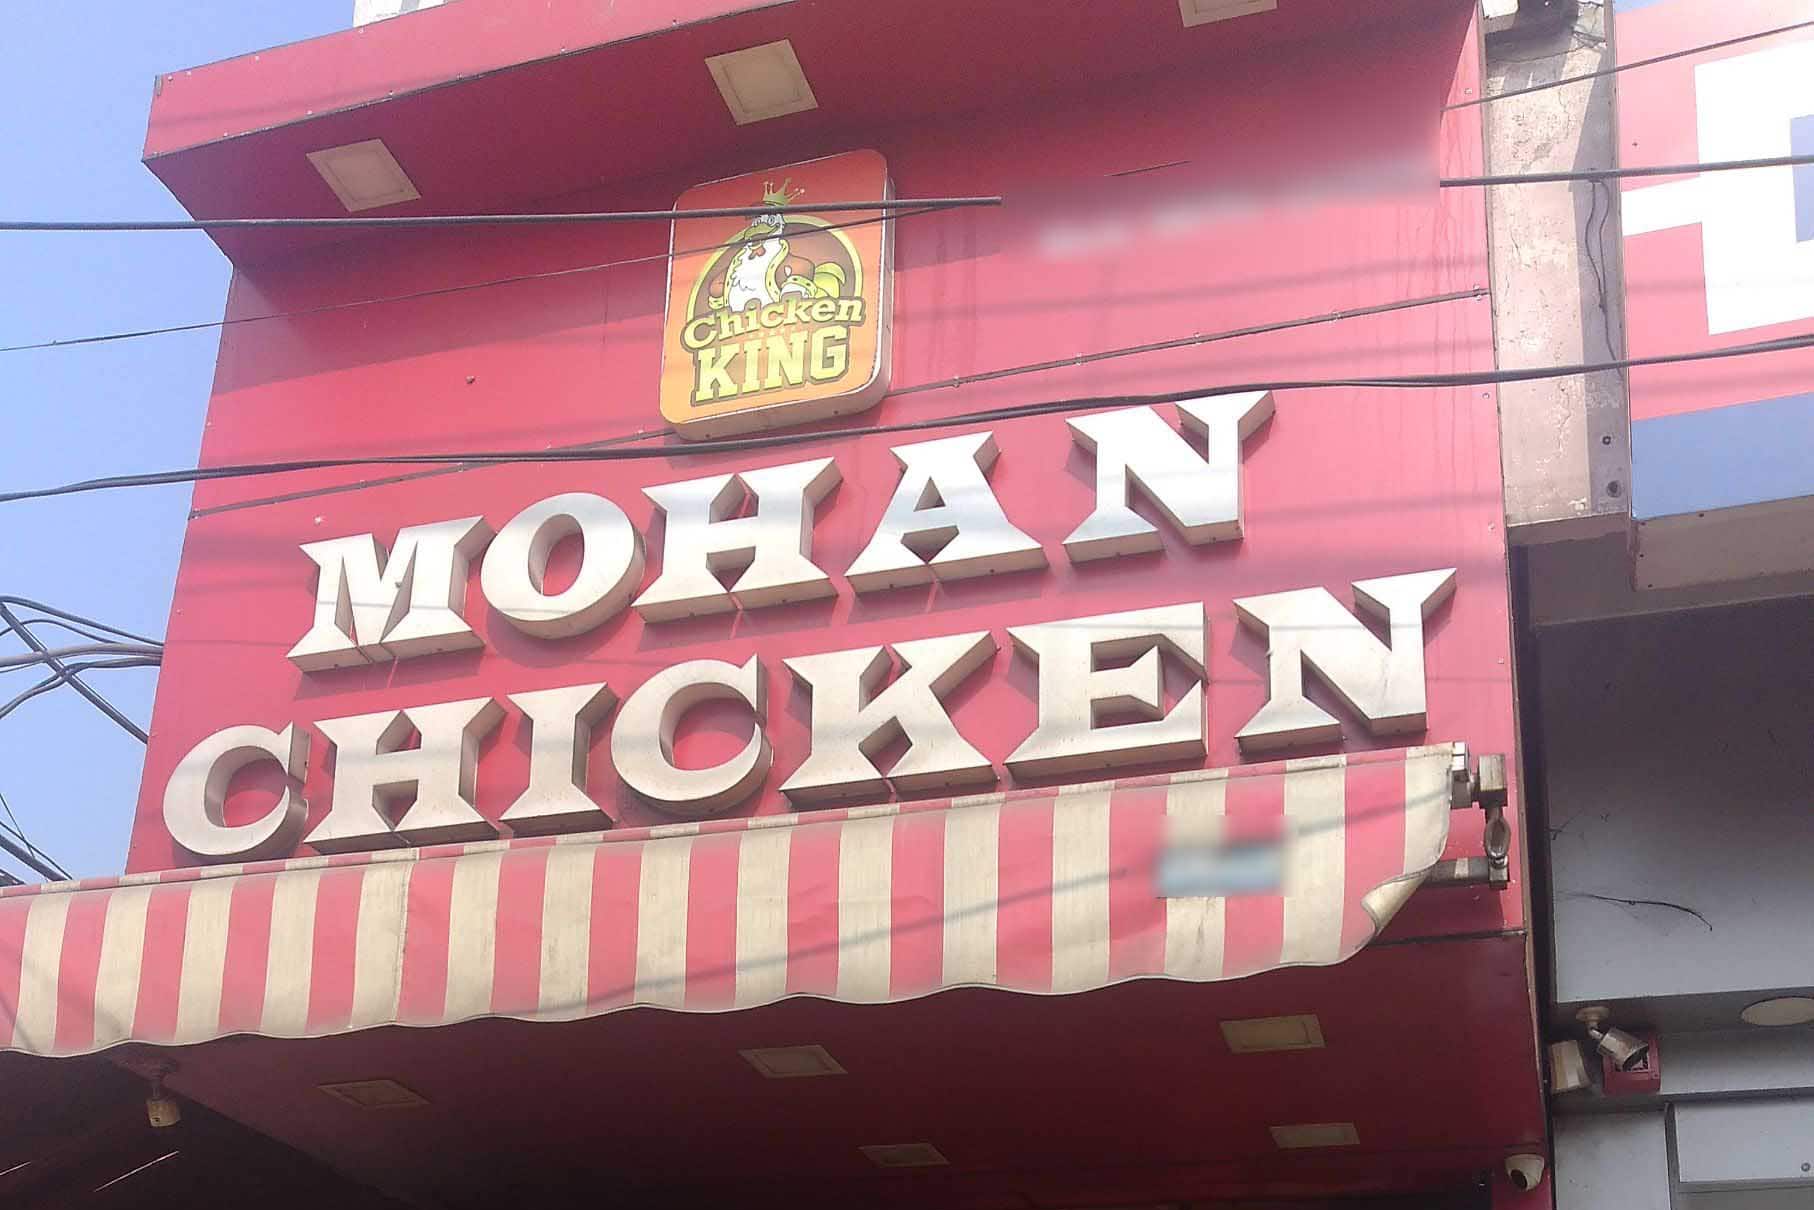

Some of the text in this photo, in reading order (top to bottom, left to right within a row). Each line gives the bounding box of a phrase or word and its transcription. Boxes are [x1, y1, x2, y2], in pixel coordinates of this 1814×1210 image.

[681, 295, 865, 350] Chicken
[690, 324, 850, 406] KING
[287, 390, 1274, 672] MOHAN
[163, 567, 1457, 857] CHICKEN
